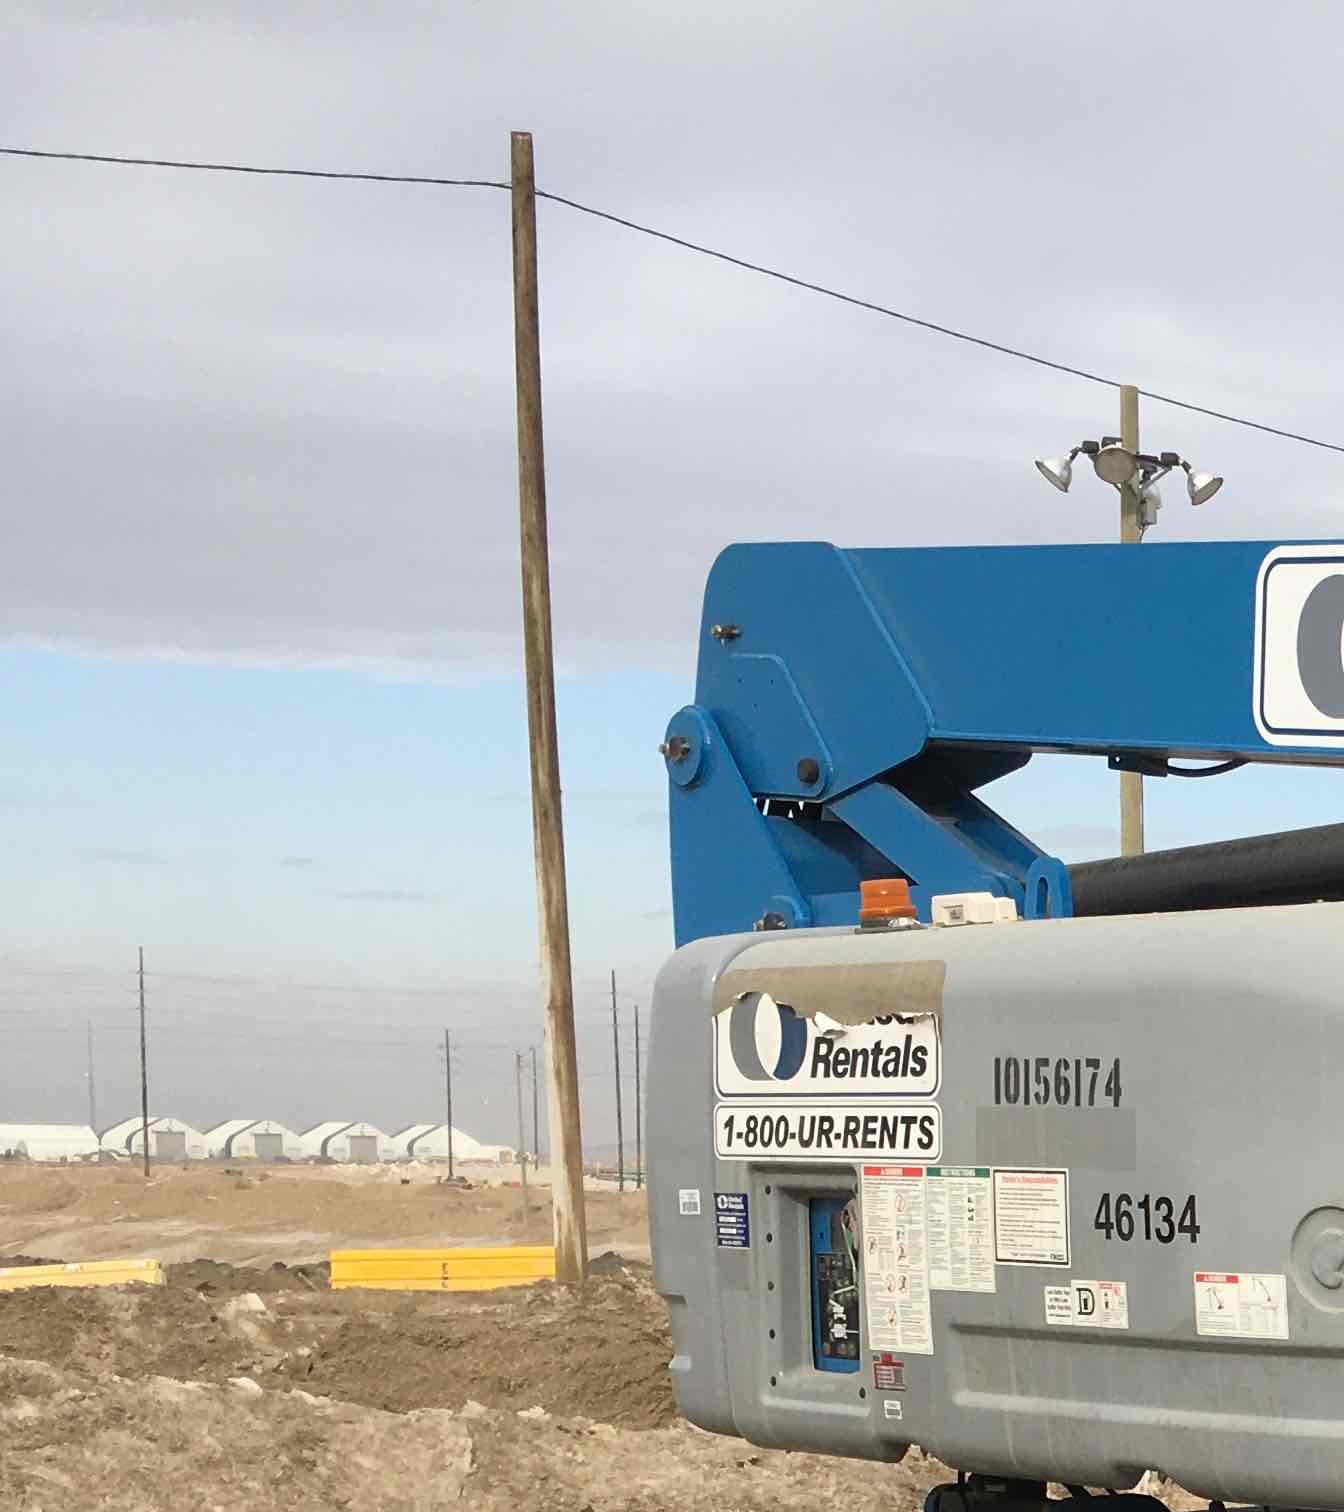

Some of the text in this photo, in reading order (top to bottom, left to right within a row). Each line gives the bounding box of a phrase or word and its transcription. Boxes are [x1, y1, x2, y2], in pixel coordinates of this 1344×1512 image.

[810, 1033, 928, 1078] Rentals
[993, 1057, 1122, 1107] 10156174
[723, 1114, 935, 1150] 1-800-UR-RENTS
[1094, 1193, 1200, 1243] 46134
